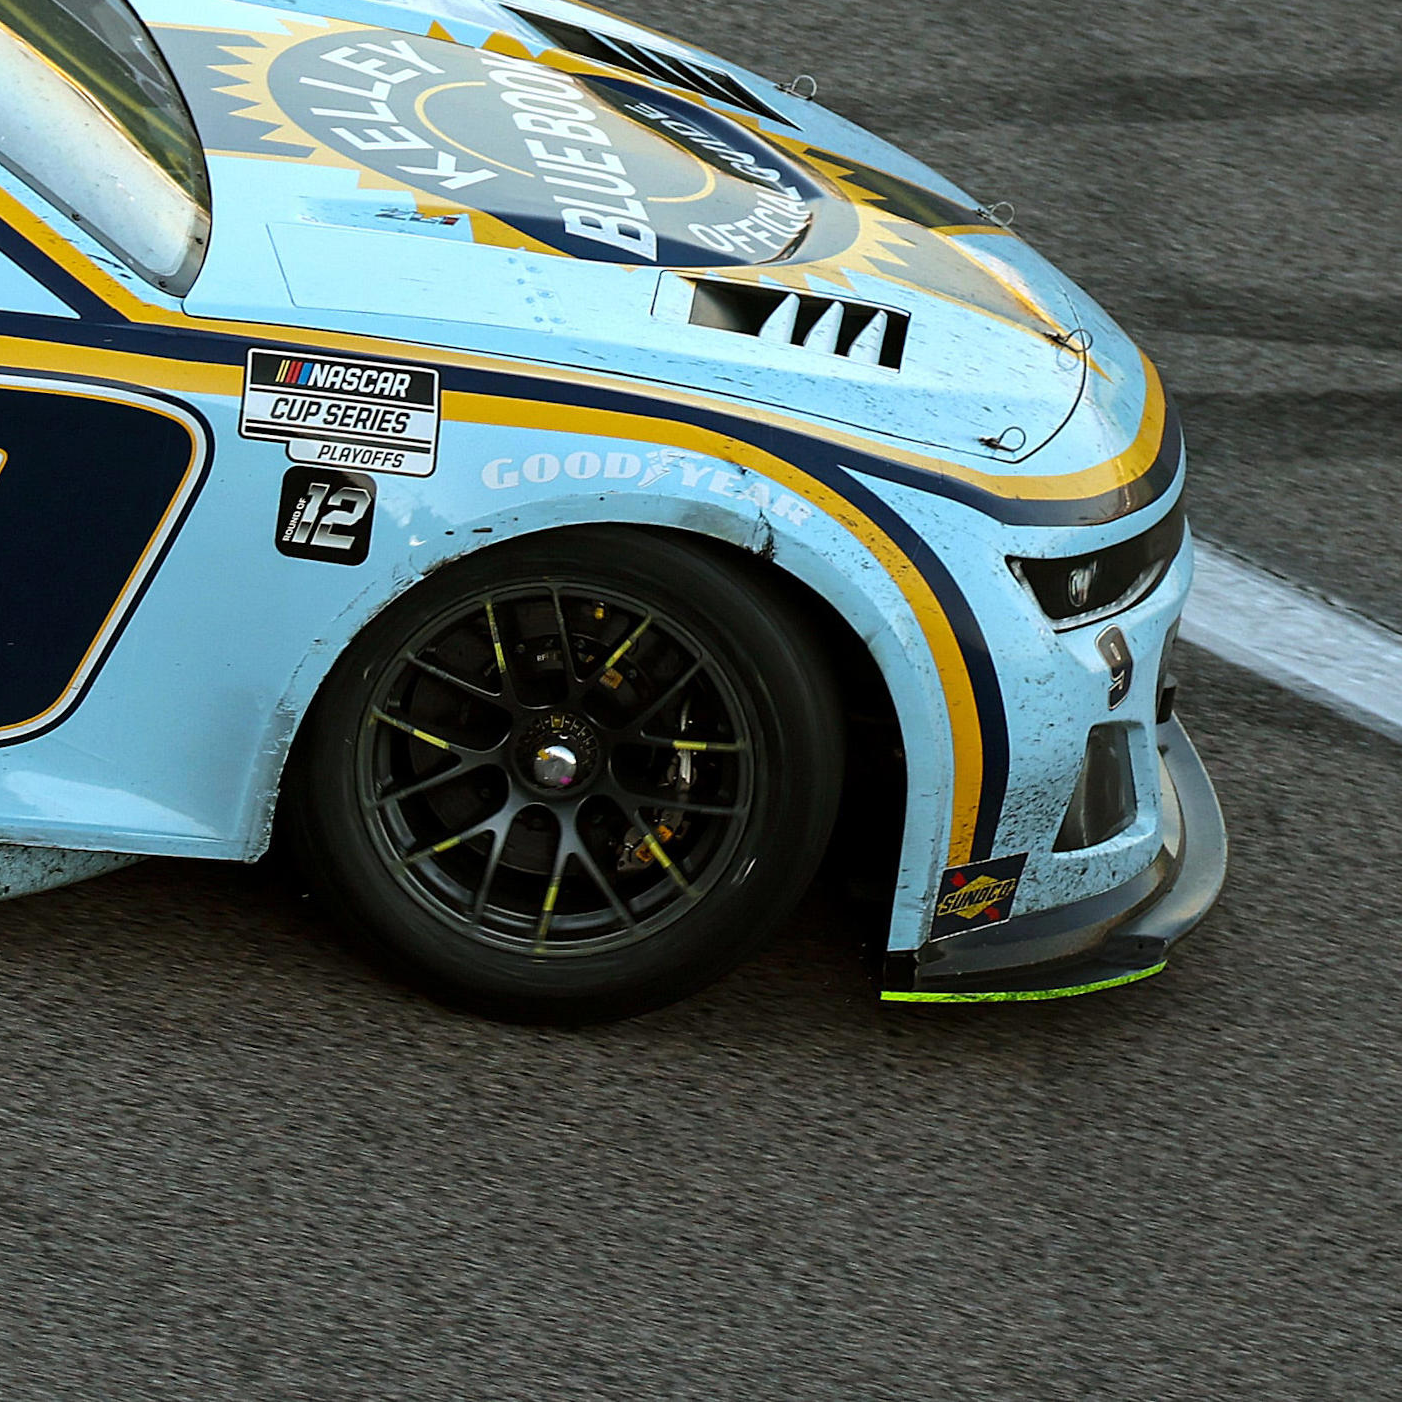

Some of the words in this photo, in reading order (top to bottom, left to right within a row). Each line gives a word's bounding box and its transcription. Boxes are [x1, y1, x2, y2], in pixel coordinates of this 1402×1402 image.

[298, 39, 499, 190] KELLEY
[523, 138, 658, 262] BLUE
[307, 362, 411, 398] NASCAR
[270, 397, 322, 423] CUP
[322, 401, 411, 434] SERIES
[317, 444, 405, 468] PLAYOFFS
[481, 450, 814, 526] GOODYEAR
[282, 510, 302, 541] ROUND
[296, 498, 307, 510] OF
[291, 482, 372, 550] 12
[938, 879, 1016, 915] SUNOCO
